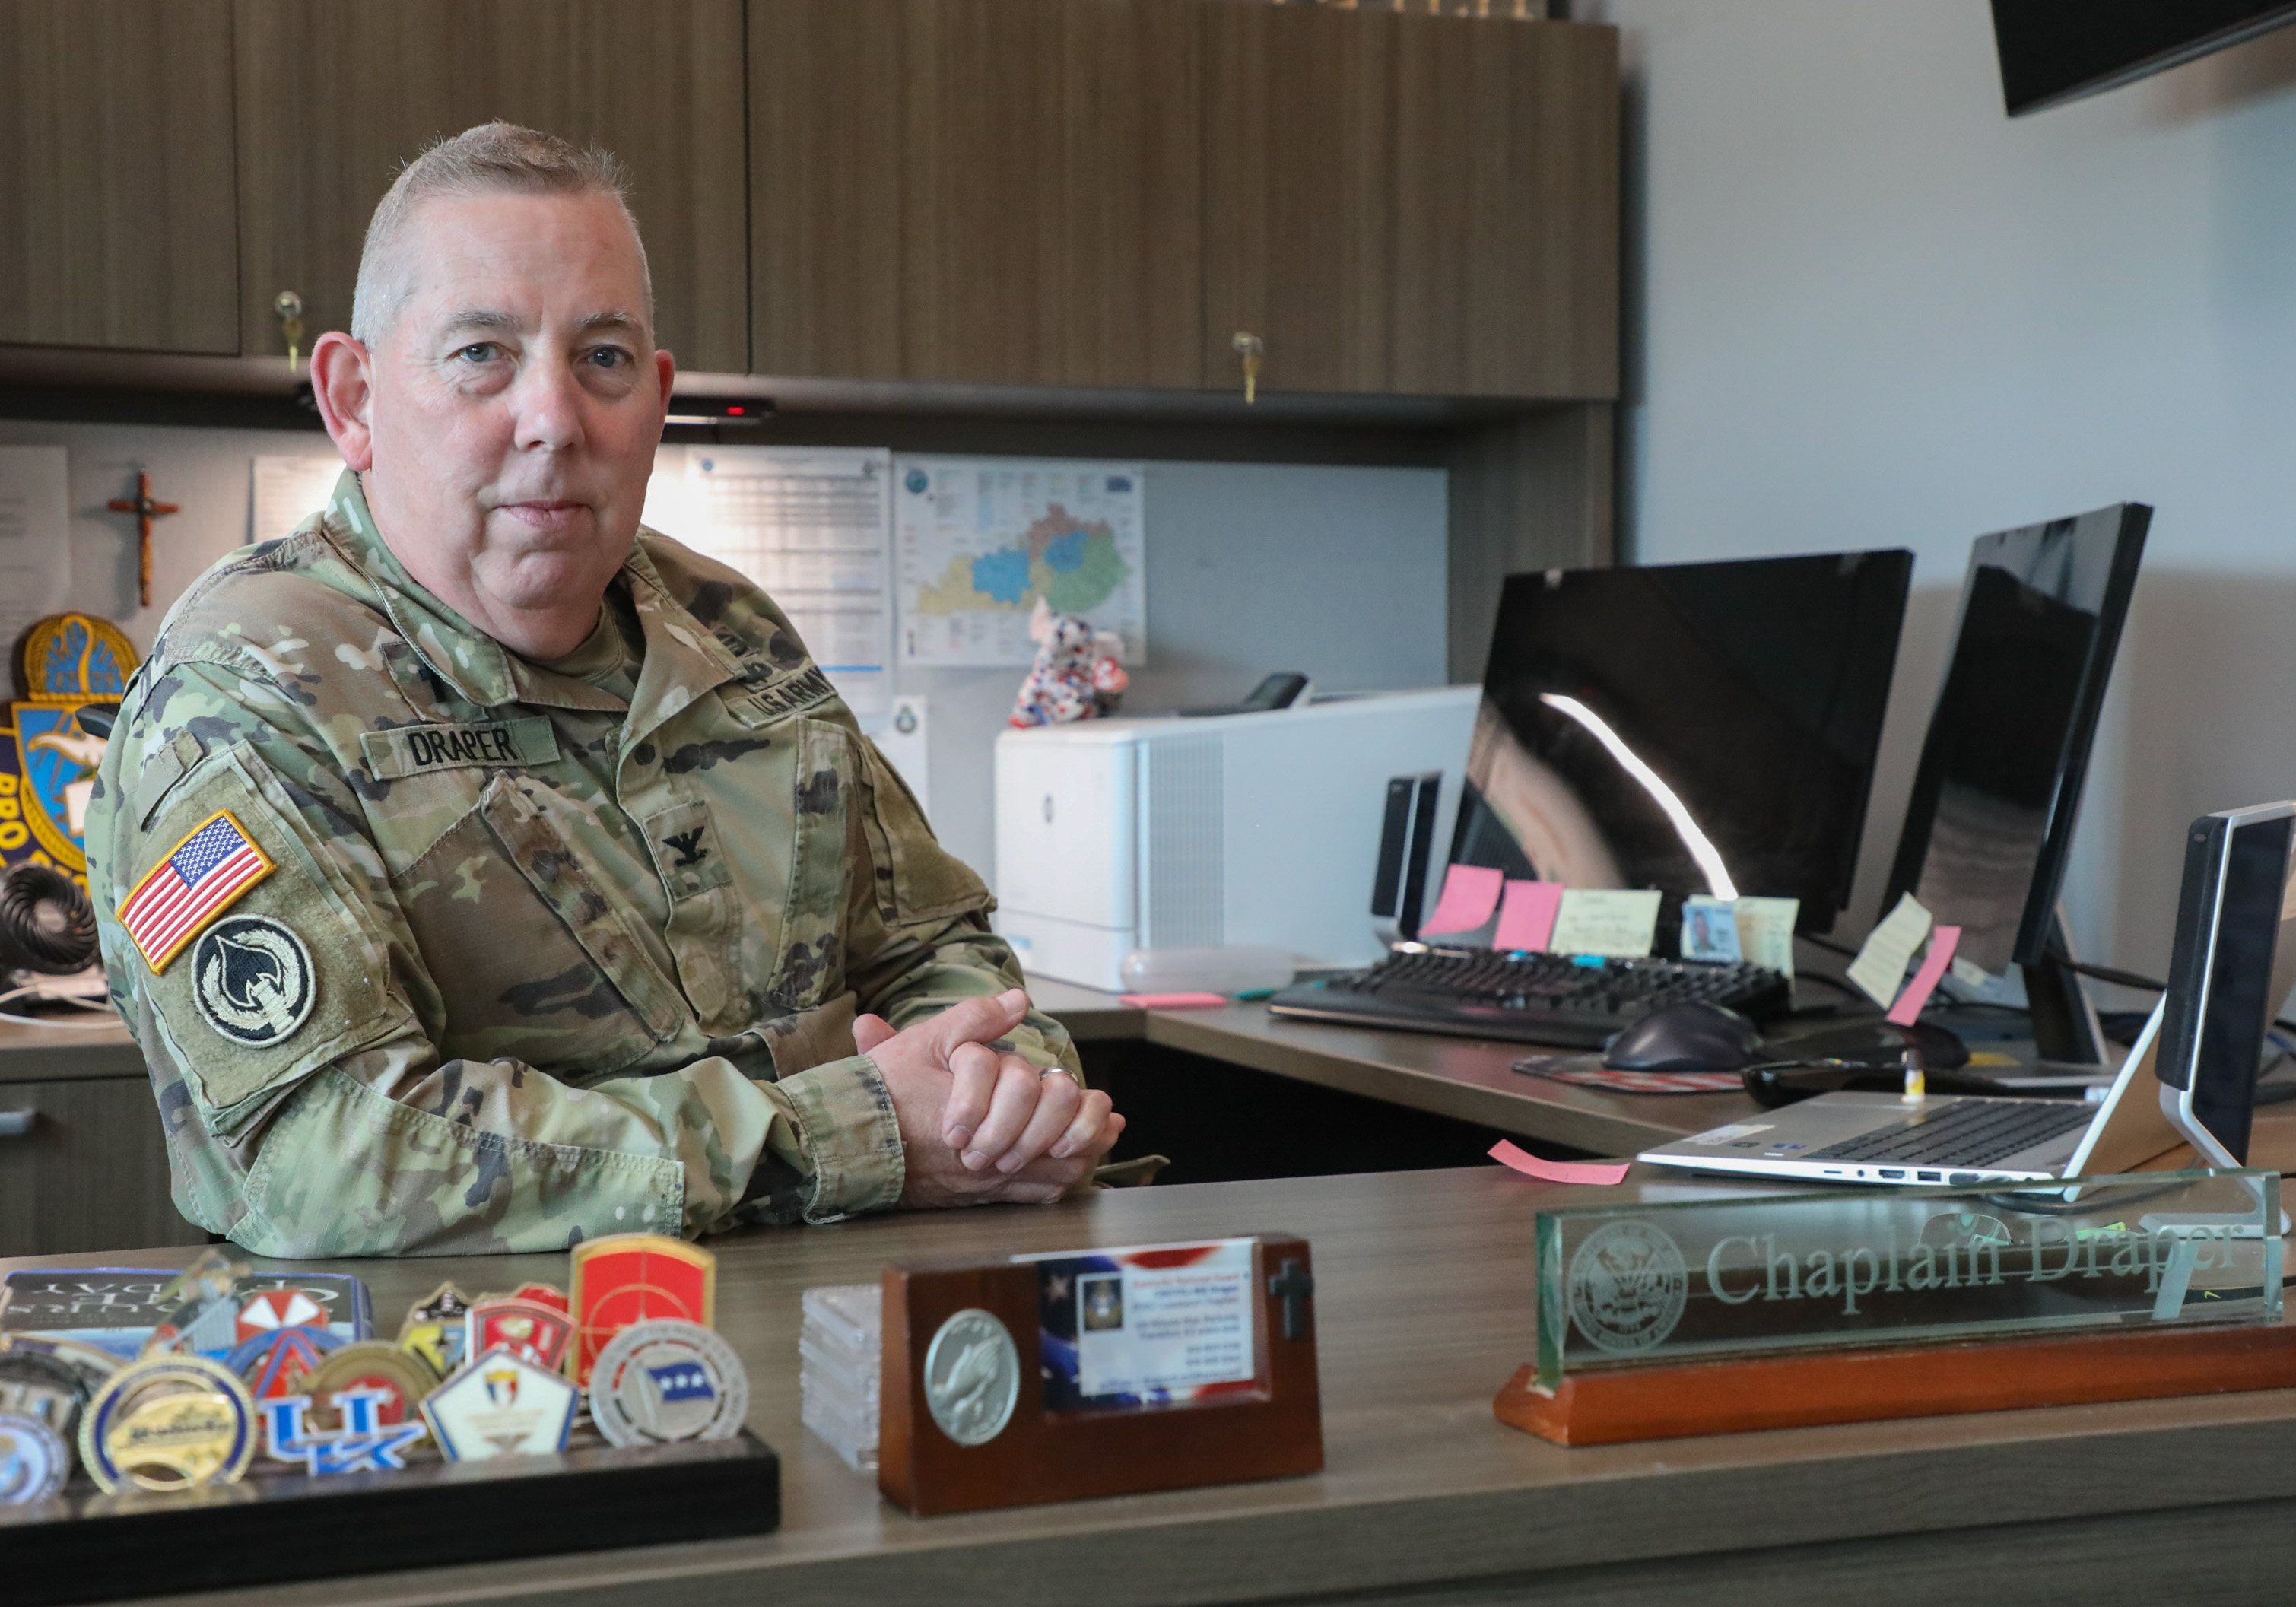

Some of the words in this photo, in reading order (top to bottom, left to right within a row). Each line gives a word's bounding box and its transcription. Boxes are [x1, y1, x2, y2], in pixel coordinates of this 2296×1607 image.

[407, 728, 518, 767] DRAPER
[1707, 1223, 2005, 1315] Chaplain
[2026, 1215, 2244, 1294] Draper
